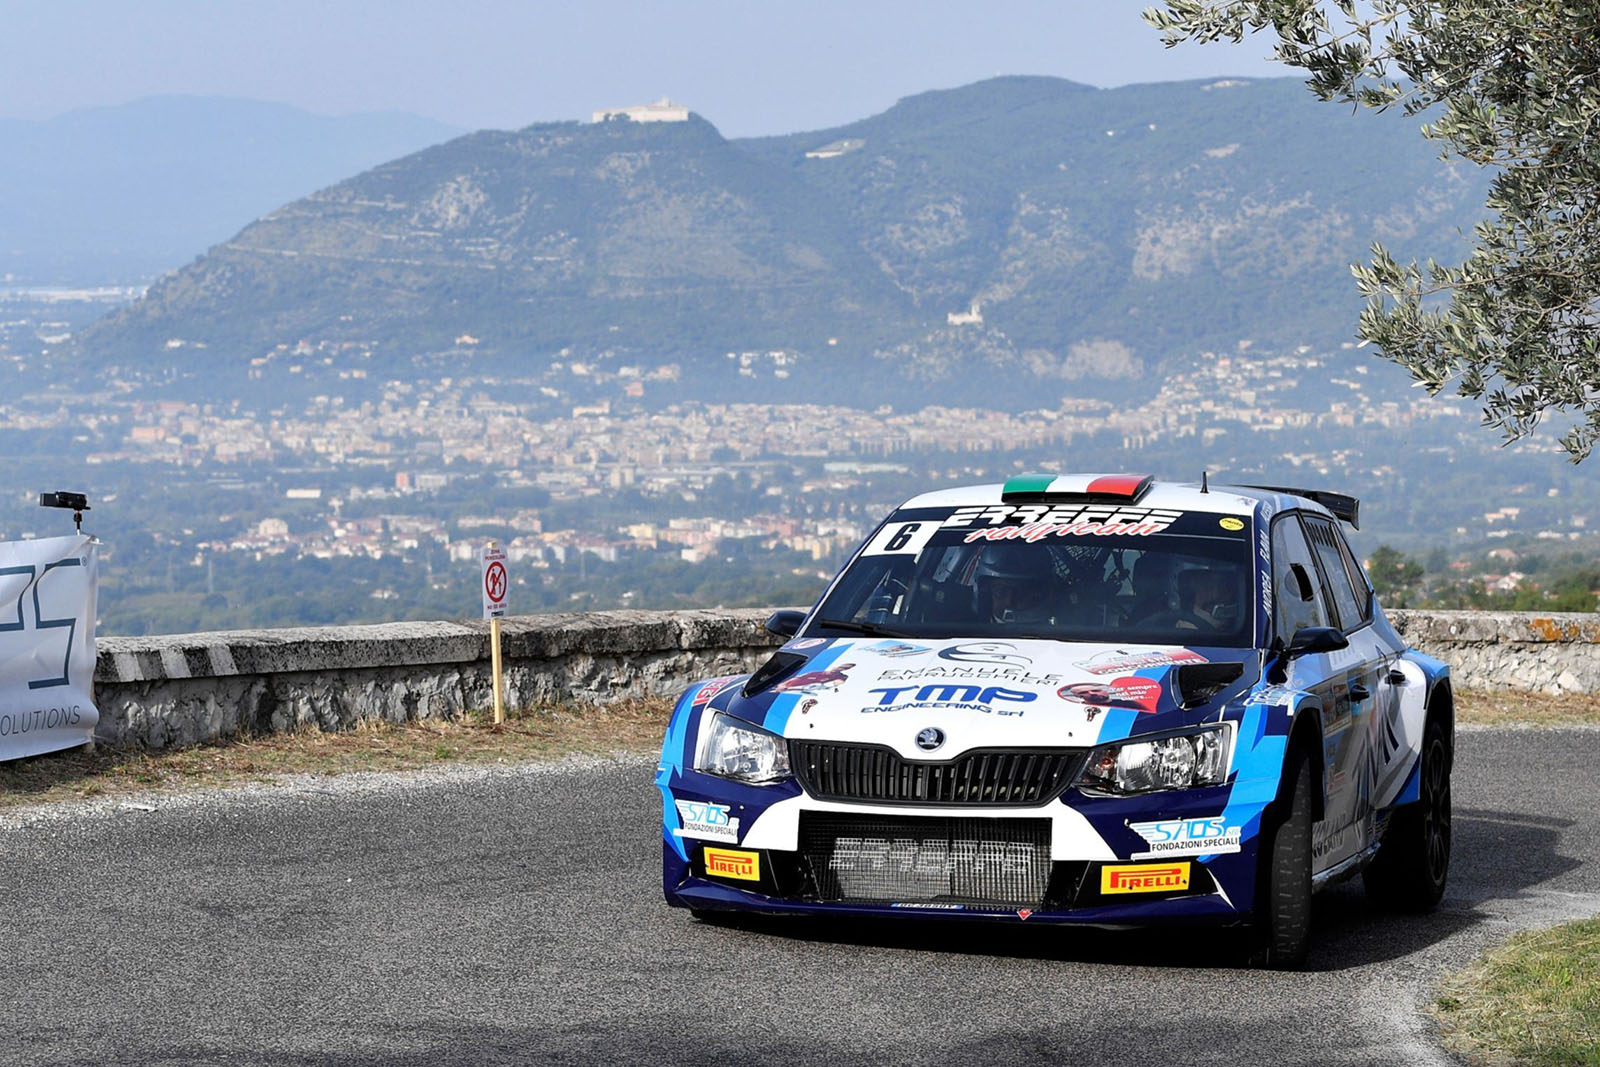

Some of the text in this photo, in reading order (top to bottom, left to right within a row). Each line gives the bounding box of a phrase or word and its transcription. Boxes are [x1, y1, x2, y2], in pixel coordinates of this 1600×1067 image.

[883, 523, 922, 551] 6
[882, 666, 1064, 682] EMANUELE
[868, 685, 1038, 705] TMP
[860, 702, 992, 713] ENGINEERING
[0, 705, 81, 736] OLUTIONS
[685, 821, 737, 836] FONDAZIONI SPECIALI
[1152, 838, 1238, 851] FONDAZIONI SPECIALI
[709, 853, 753, 875] PIRELLI
[1110, 868, 1182, 888] PIRELLI
